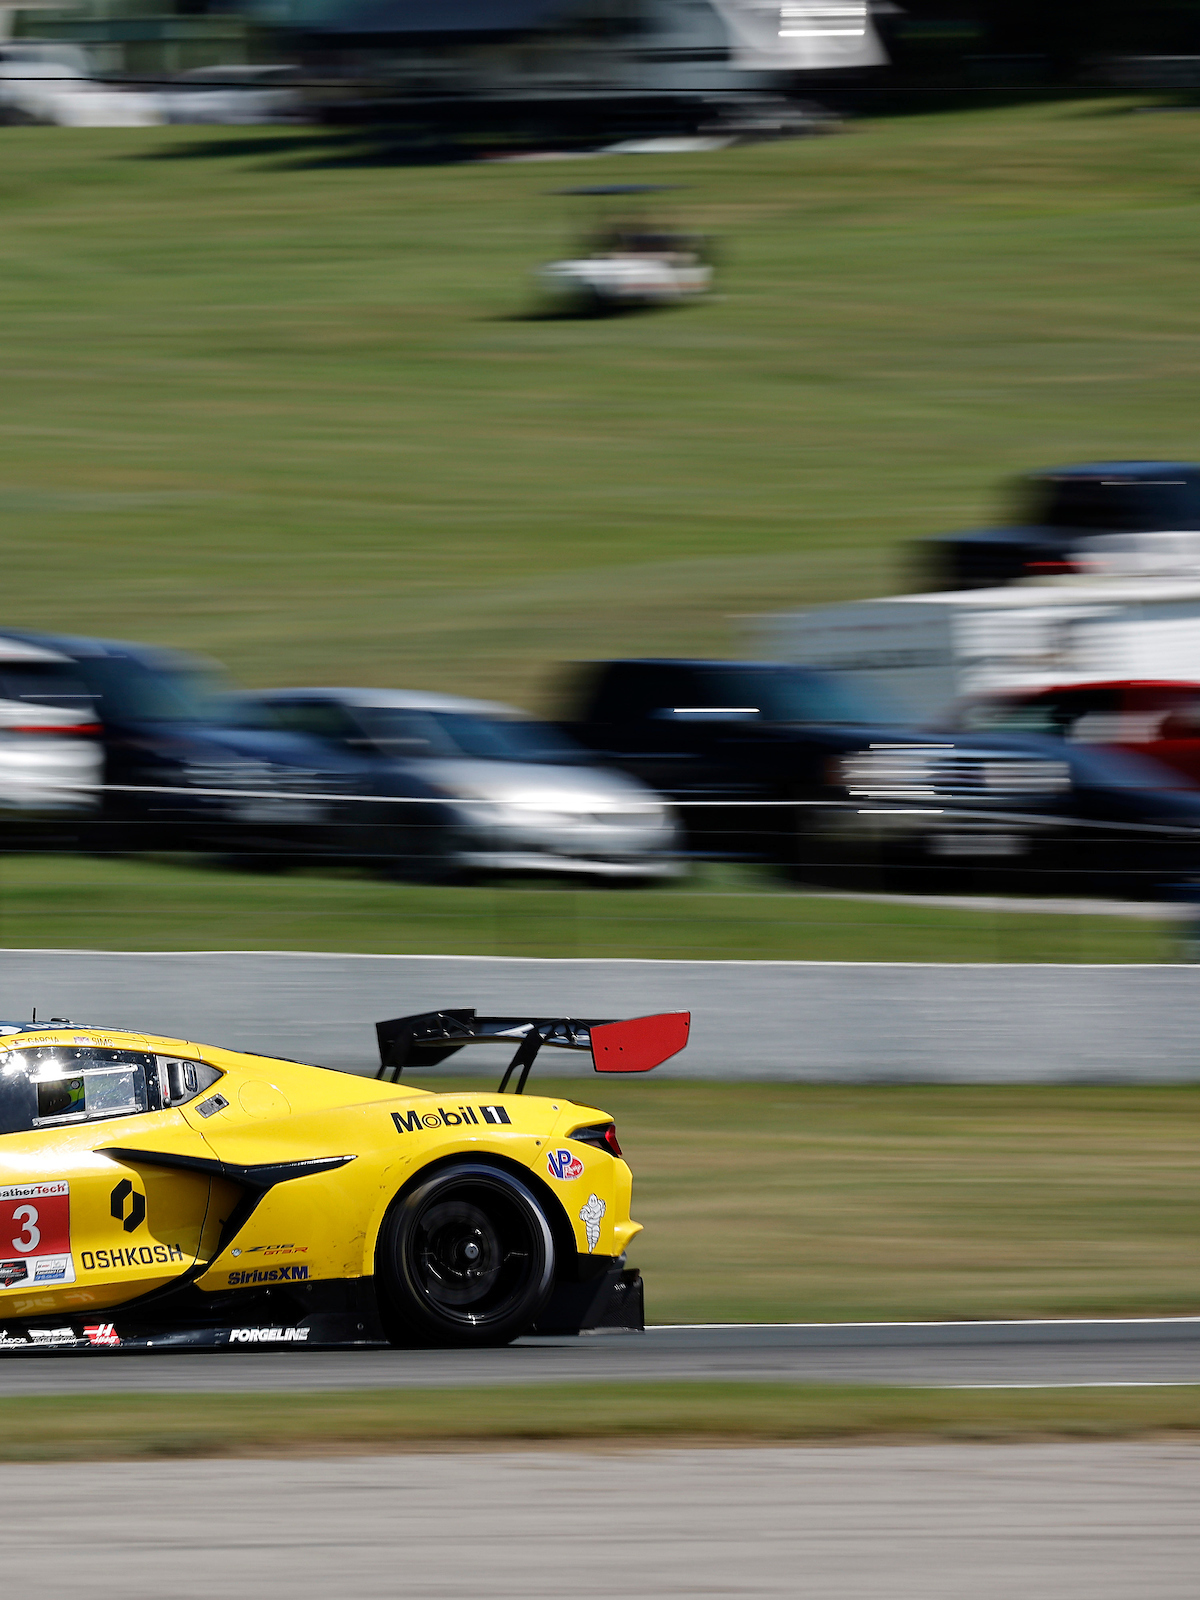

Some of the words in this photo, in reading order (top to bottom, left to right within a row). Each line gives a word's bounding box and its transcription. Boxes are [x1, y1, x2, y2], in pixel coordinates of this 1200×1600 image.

[27, 1036, 60, 1044] GARCIA
[91, 1037, 115, 1047] SIMS
[390, 1106, 479, 1134] Mobil
[548, 1150, 571, 1178] VP
[11, 1204, 41, 1253] 3
[81, 1243, 183, 1269] OSHKOSH
[227, 1265, 309, 1285] SiriusXM
